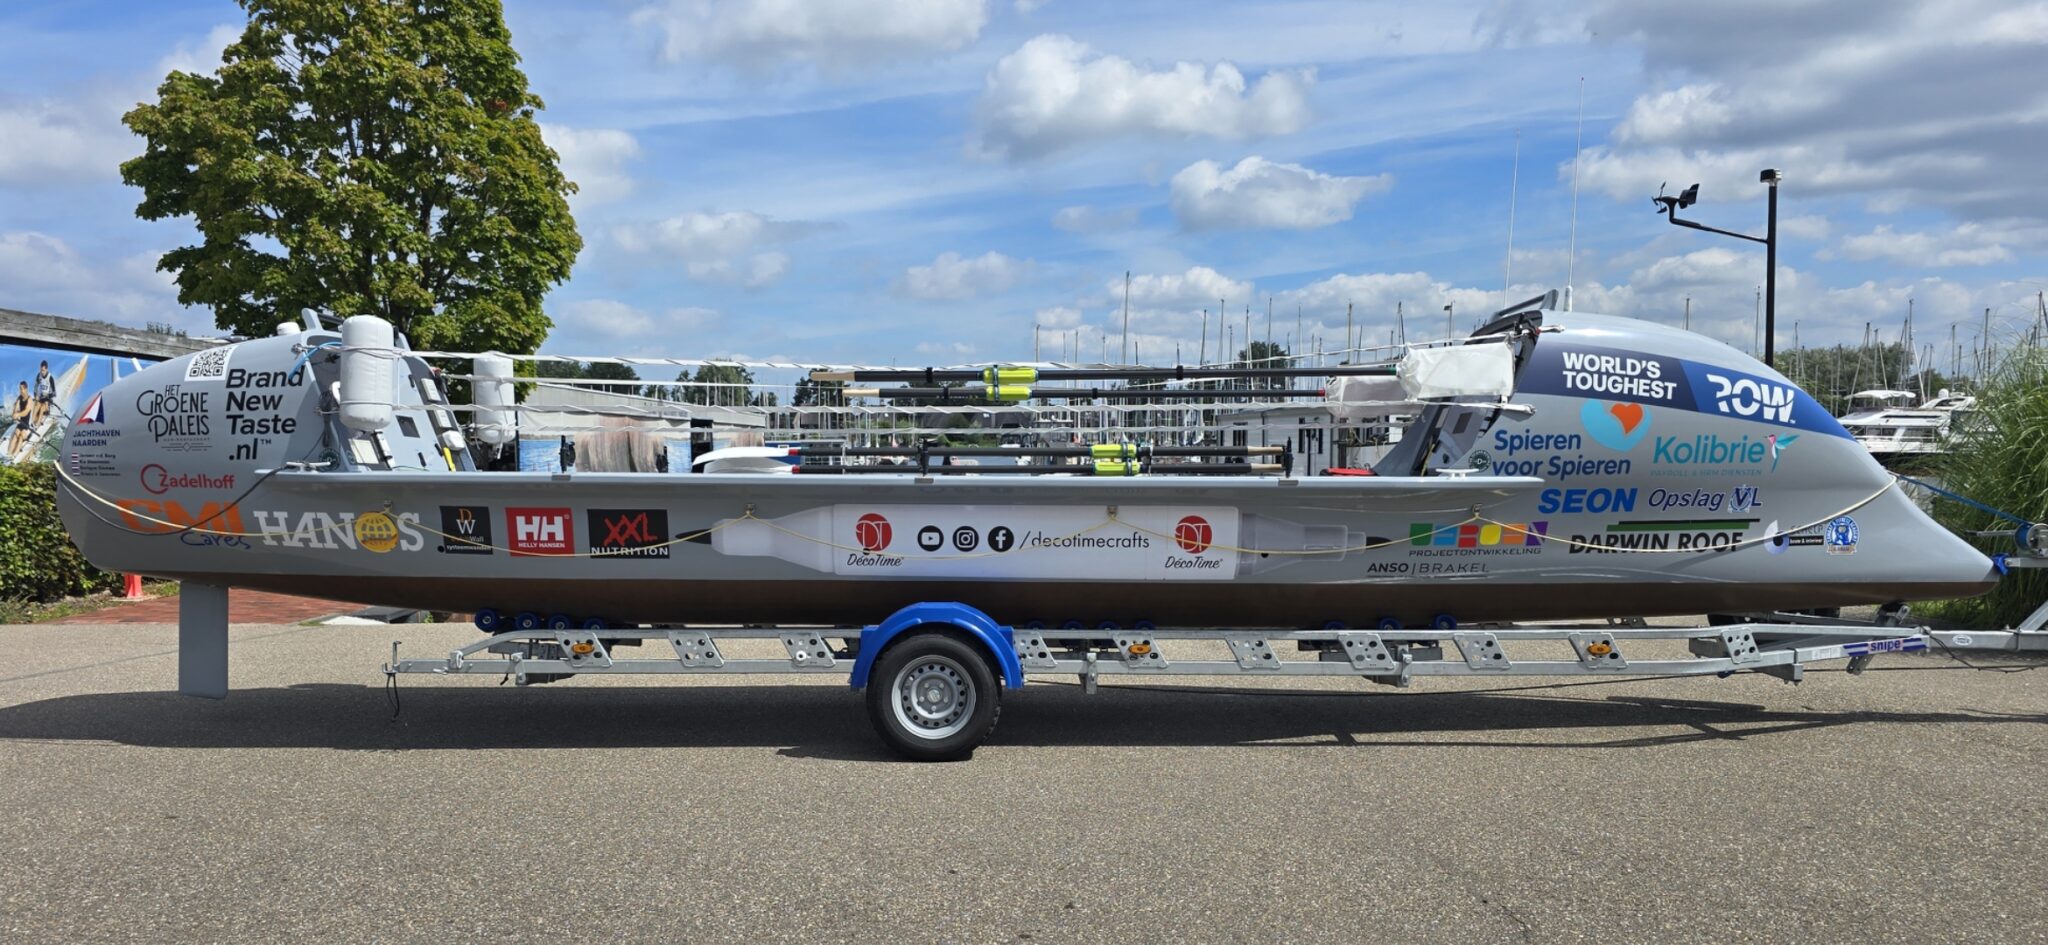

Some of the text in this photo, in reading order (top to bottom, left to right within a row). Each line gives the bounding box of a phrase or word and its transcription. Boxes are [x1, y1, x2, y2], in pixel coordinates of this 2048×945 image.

[226, 365, 305, 388] Brand
[1562, 371, 1677, 400] TOUGHEST
[165, 384, 181, 397] HET
[226, 391, 283, 411] New
[1706, 373, 1795, 423] ROW
[136, 390, 209, 416] GROENE
[73, 429, 121, 438] JACHTHAVEN
[148, 414, 210, 443] PALEIS
[226, 414, 297, 435] Taste
[72, 439, 107, 447] NAARDEN
[1494, 428, 1582, 456] Spieren
[1652, 434, 1766, 465] Kolibrie
[1493, 460, 1543, 477] voor
[1547, 454, 1631, 481] Spieren
[1538, 488, 1638, 514] SEON
[1648, 488, 1724, 512] Opslag
[515, 515, 565, 541] HH
[603, 512, 658, 546] XXL
[180, 531, 251, 550] Cares
[1019, 531, 1150, 549] /decotimecrafts
[1569, 532, 1744, 554] DARWIN ROOF
[591, 547, 669, 556] NUTRITION
[1164, 555, 1220, 568] DécoTime
[1408, 548, 1542, 557] PROJECTONTWIKKELING
[1367, 563, 1409, 573] ANSO
[1419, 562, 1489, 573] BRAKEL
[1870, 640, 1901, 652] snipe
